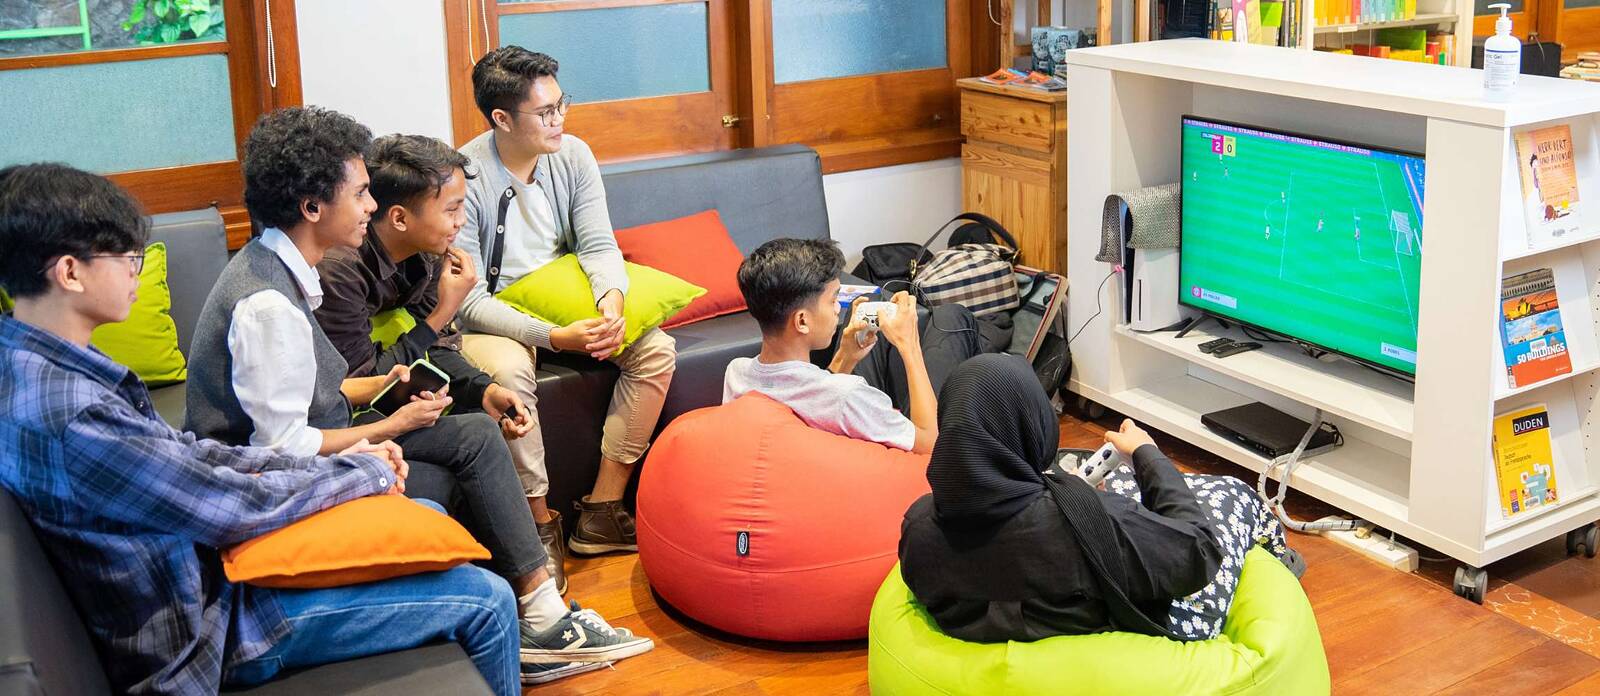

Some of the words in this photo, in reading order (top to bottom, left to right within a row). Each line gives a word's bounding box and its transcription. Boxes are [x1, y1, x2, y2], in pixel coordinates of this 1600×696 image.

[1215, 141, 1221, 152] 2
[1227, 143, 1233, 153] 0
[1290, 136, 1312, 145] STRAUSS
[1318, 142, 1341, 151] STRAUSS
[1346, 146, 1371, 155] STRAUSS
[1527, 342, 1566, 361] BUILDINGS
[1514, 417, 1543, 433] DUDEN
